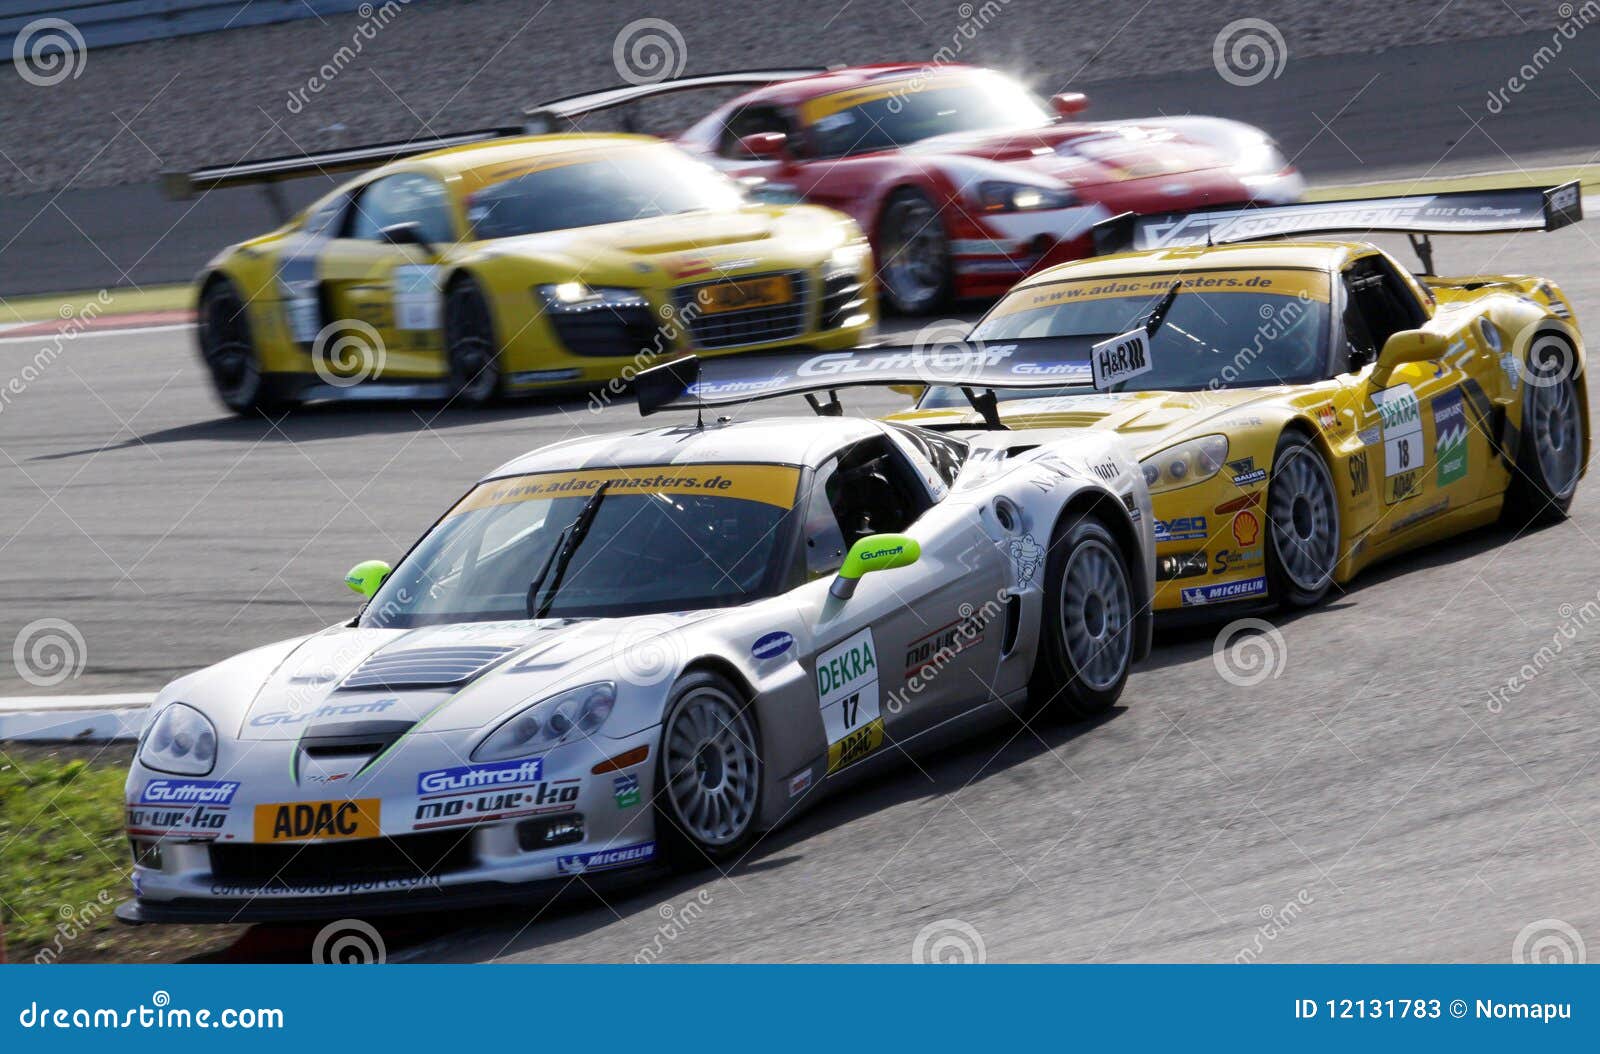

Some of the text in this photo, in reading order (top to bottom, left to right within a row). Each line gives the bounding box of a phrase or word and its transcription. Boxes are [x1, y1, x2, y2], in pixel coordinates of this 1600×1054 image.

[1034, 276, 1272, 304] www.adac-msters.de
[797, 344, 1017, 376] Guttroff
[1398, 439, 1409, 468] 18
[493, 473, 732, 500] www.adacmasters.de
[1209, 579, 1264, 598] MICHELIN
[818, 640, 876, 697] DEKRA
[842, 693, 860, 730] 17
[838, 728, 873, 767] ADAC
[144, 781, 237, 801] Guttroff
[421, 759, 539, 793] Guttroff
[272, 801, 359, 839] ADAC
[586, 843, 655, 867] MICHELIN
